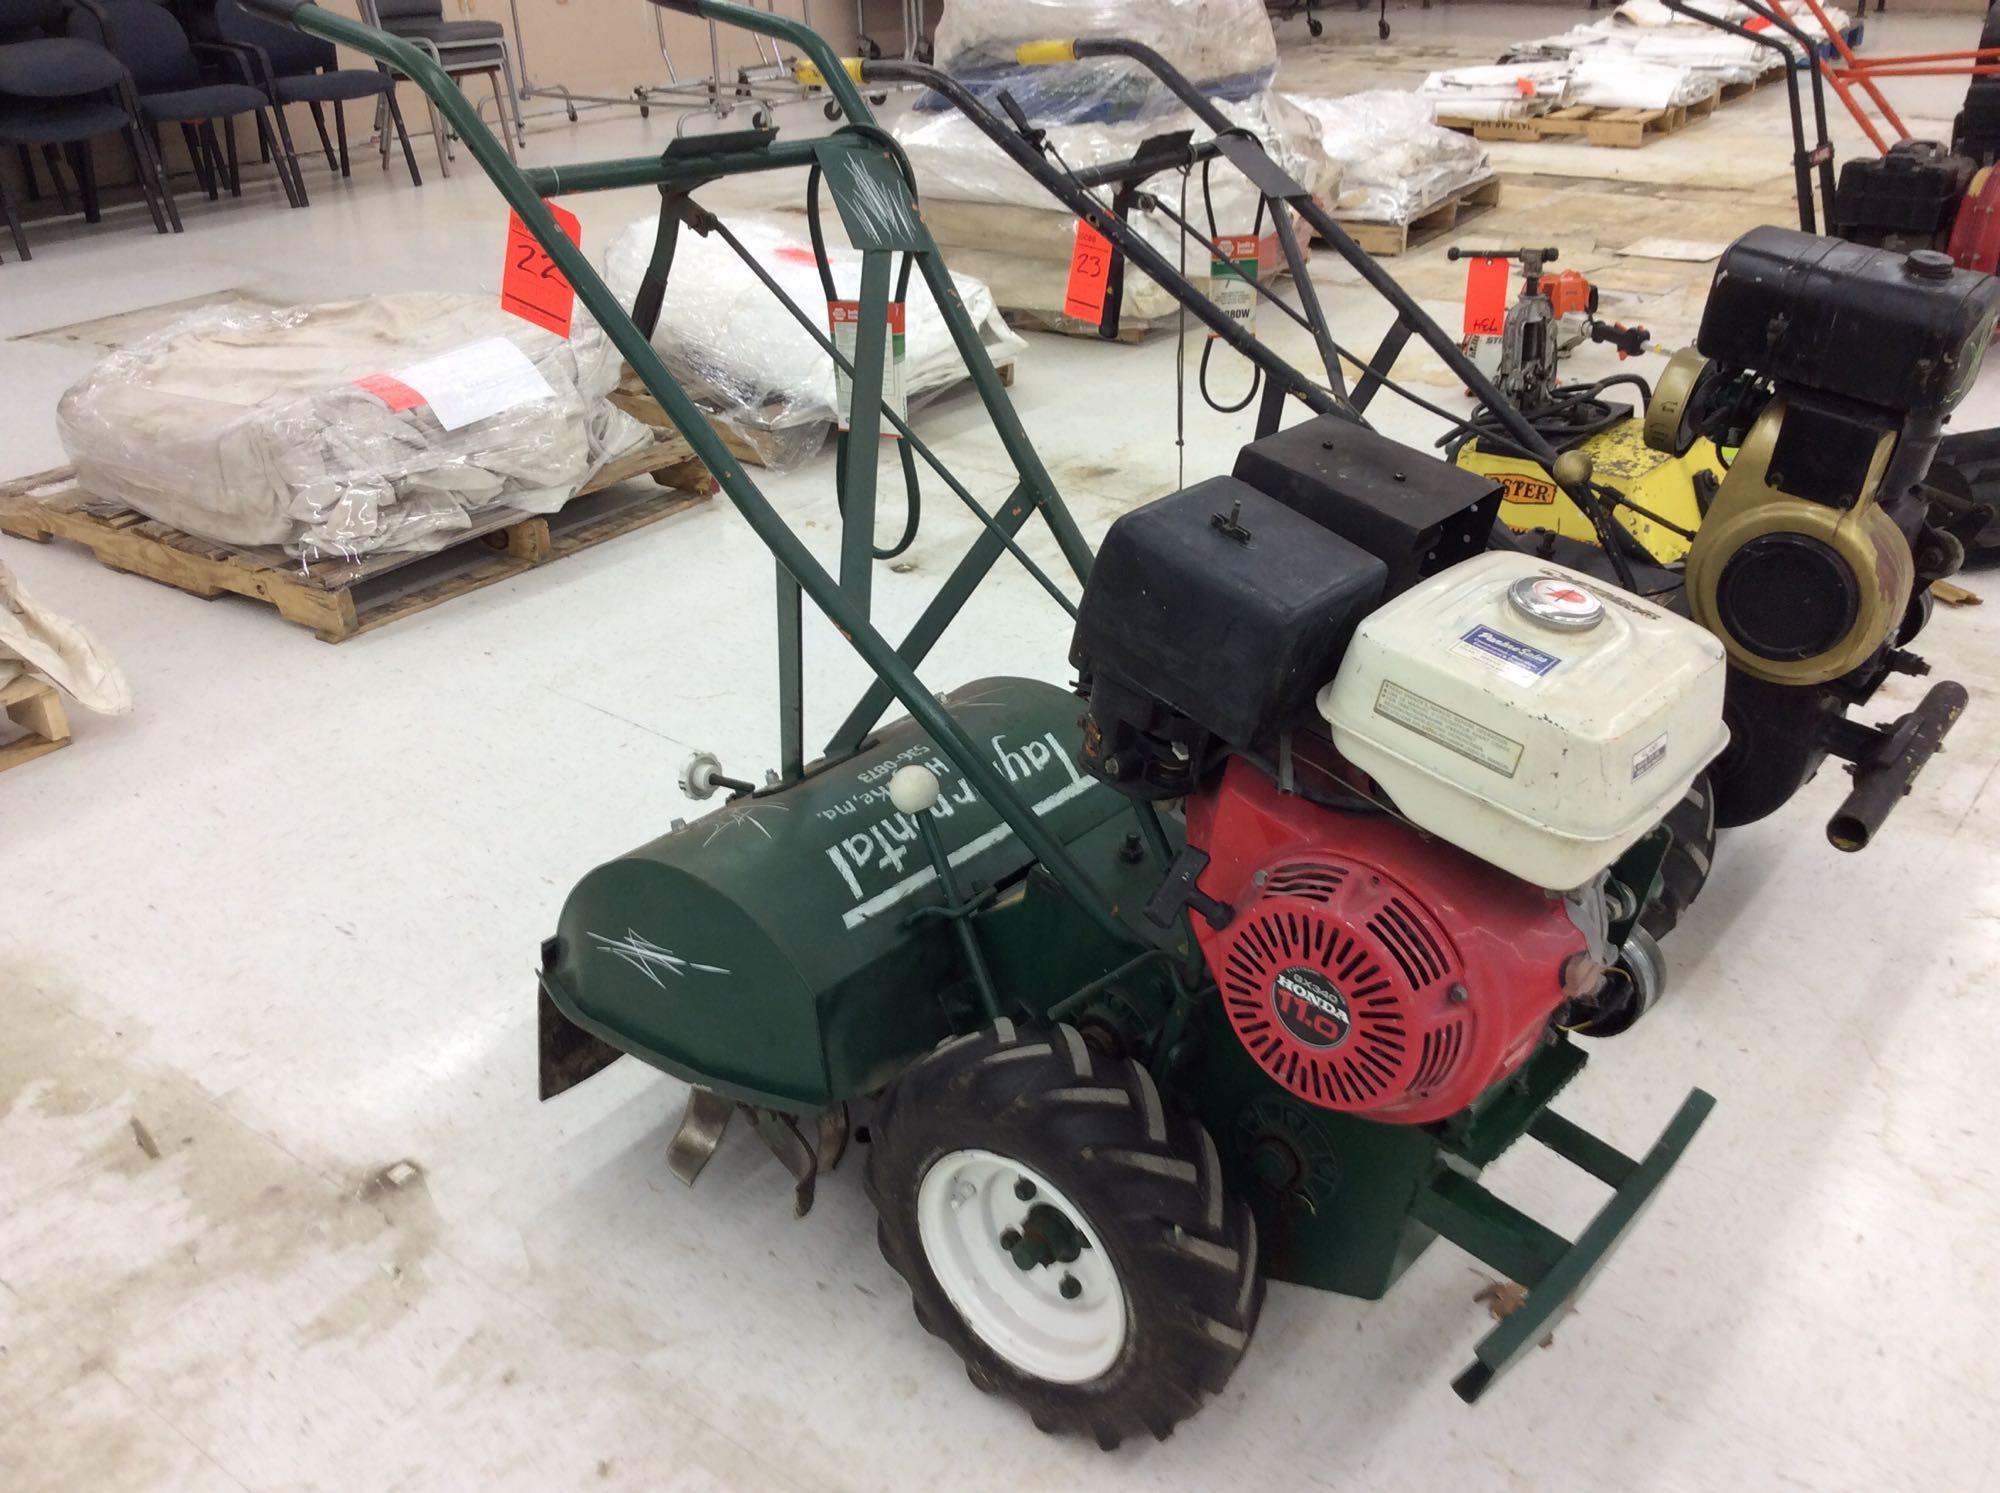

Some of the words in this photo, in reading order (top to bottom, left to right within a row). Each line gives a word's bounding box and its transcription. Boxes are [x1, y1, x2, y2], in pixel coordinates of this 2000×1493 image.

[1077, 253, 1101, 277] 23
[1473, 317, 1498, 332] 734
[1277, 974, 1350, 1025] HONDA
[1294, 973, 1338, 1004] GX340
[1278, 987, 1339, 1041] 11.0
